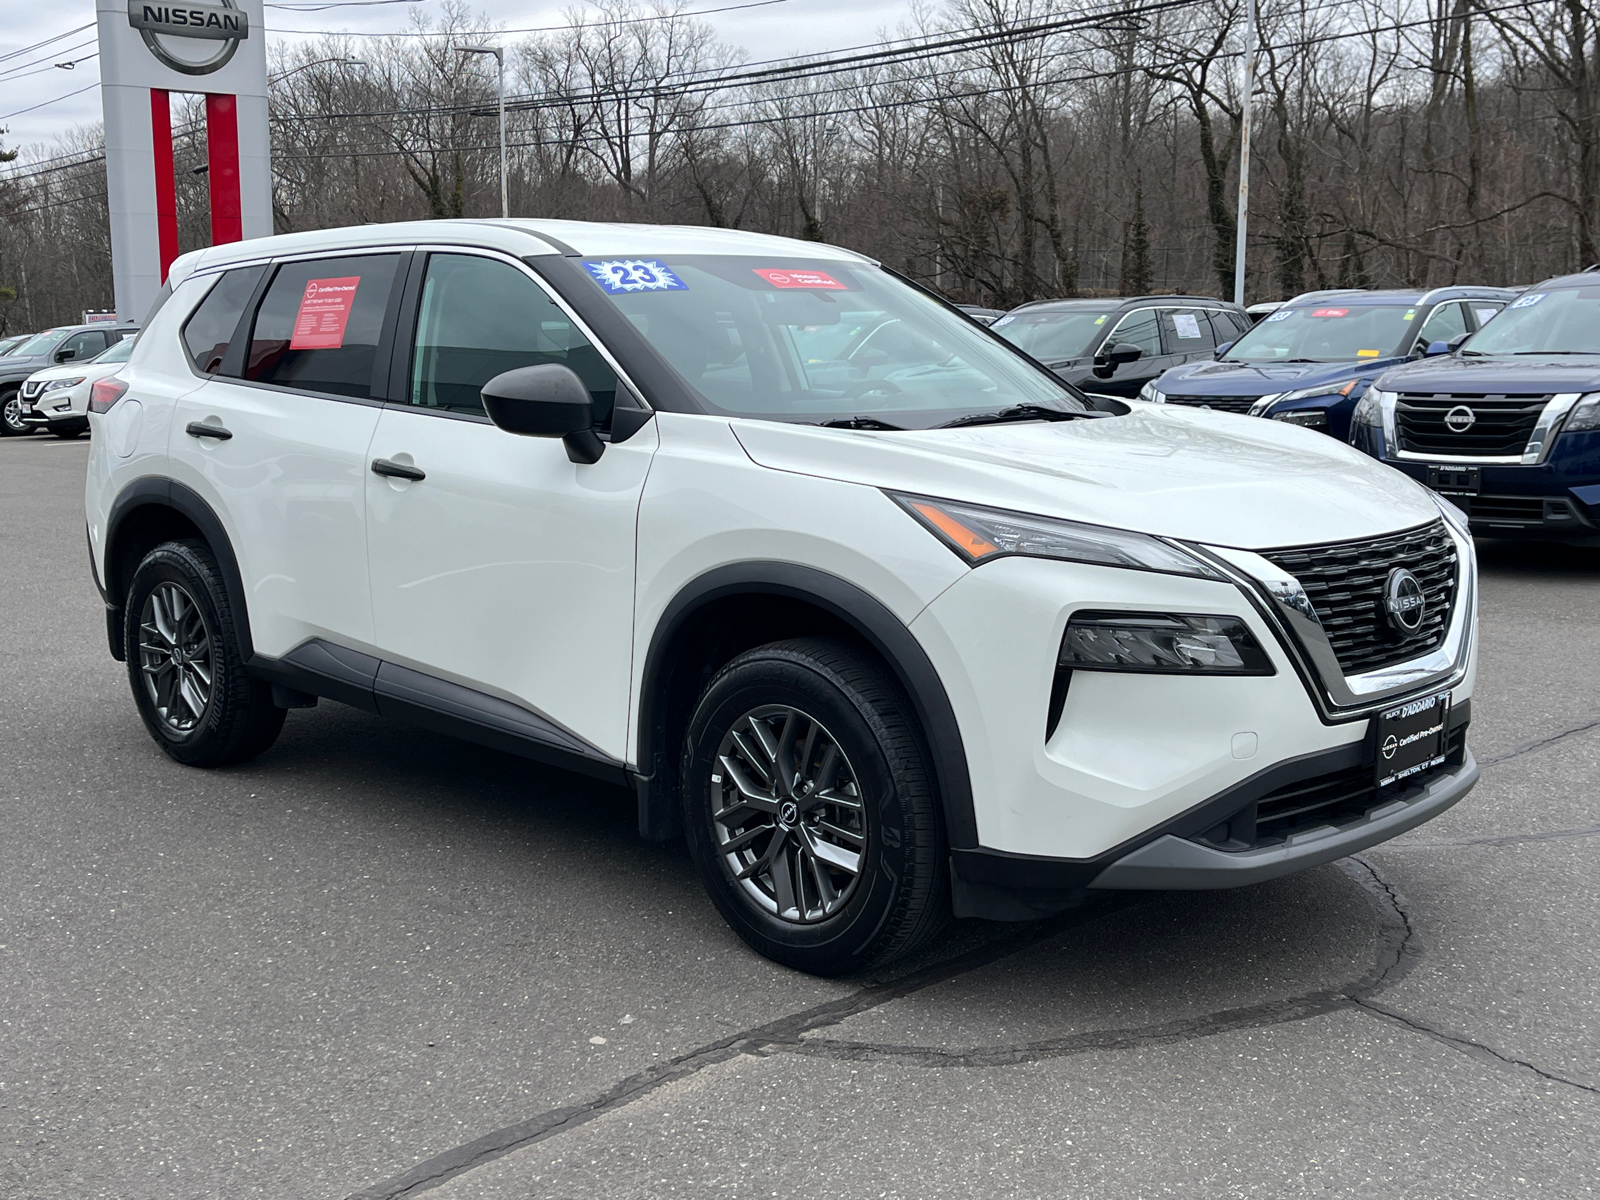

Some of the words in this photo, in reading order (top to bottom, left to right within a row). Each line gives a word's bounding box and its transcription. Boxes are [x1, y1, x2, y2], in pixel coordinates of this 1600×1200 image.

[143, 6, 239, 31] NISSAN
[611, 264, 657, 285] 23
[1389, 595, 1425, 611] NISSAN
[208, 634, 226, 733] BRIDGESTONE
[1401, 697, 1436, 718] D'ADDARIO
[1399, 732, 1420, 746] Certified
[1420, 722, 1444, 738] Pre-Owned
